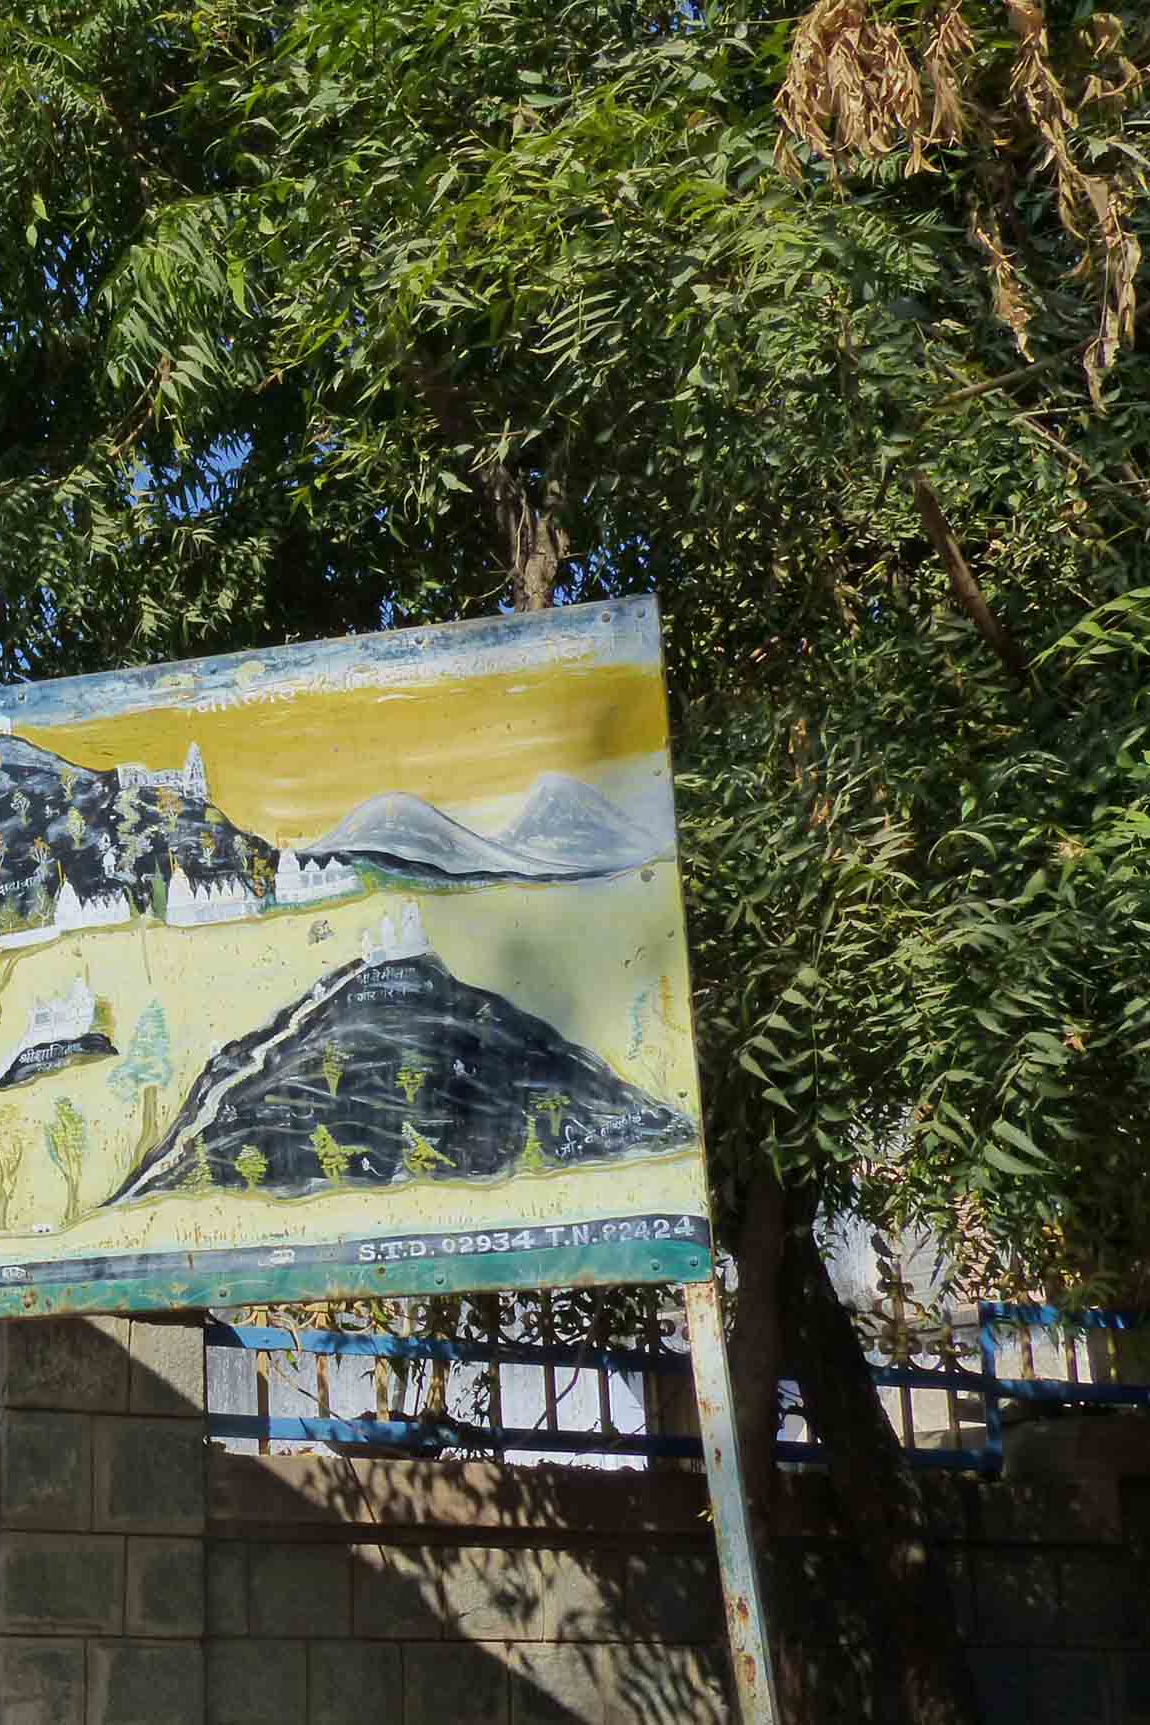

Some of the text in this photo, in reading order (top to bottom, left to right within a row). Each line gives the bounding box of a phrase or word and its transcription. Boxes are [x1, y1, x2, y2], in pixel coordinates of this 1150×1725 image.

[358, 1240, 435, 1261] S.T.D.
[442, 1230, 536, 1254] 02934
[545, 1224, 598, 1247] T.N.
